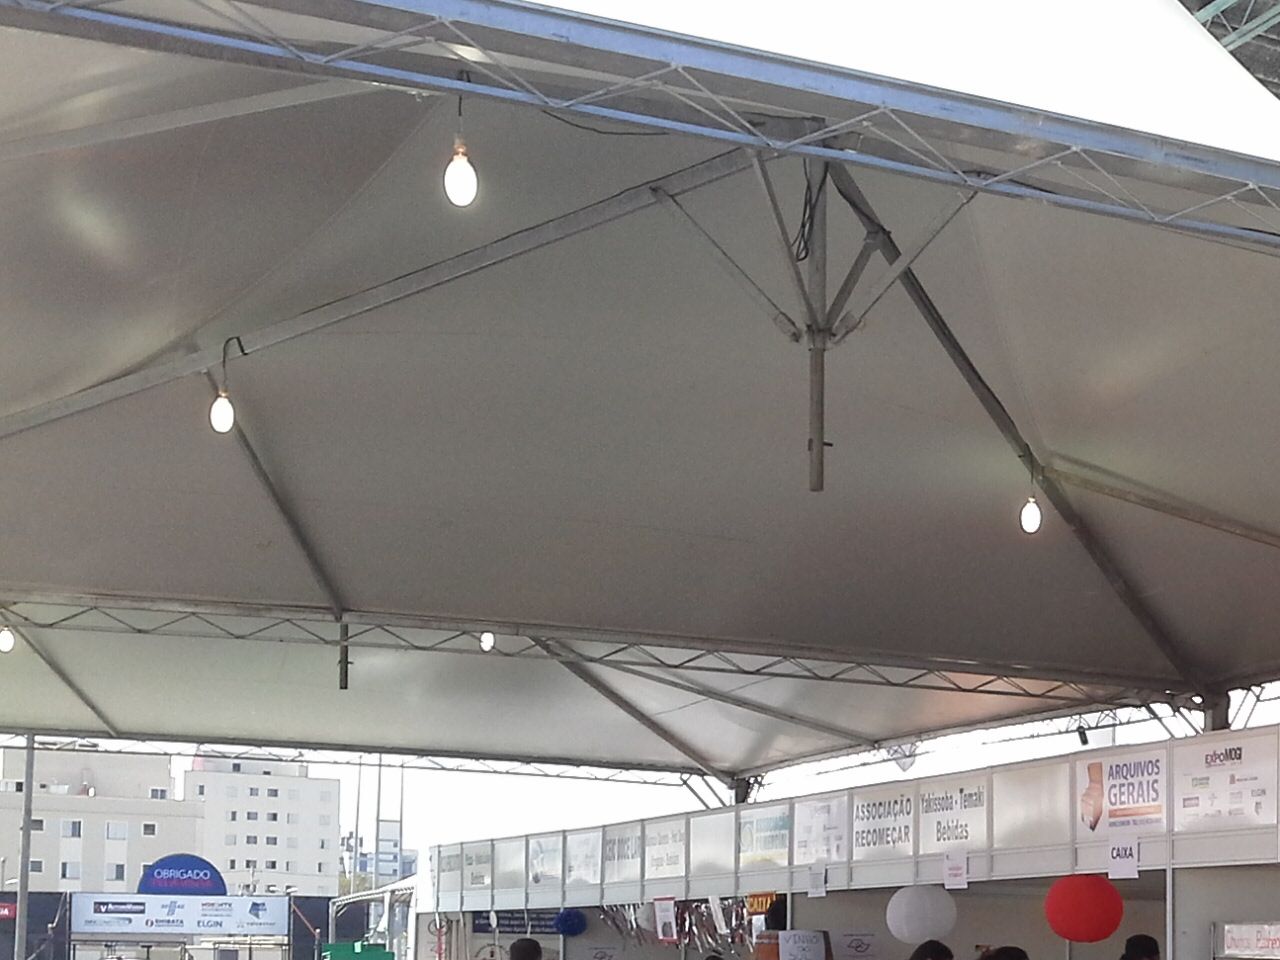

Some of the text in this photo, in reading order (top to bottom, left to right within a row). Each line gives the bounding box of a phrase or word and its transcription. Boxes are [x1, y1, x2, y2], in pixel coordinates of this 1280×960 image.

[1108, 759, 1161, 781] ARQUIVOS
[920, 790, 954, 814] Yakissoba
[959, 785, 985, 809] Temaki
[1108, 779, 1160, 806] GERAIS
[855, 794, 912, 821] ASSOCIAÇÃO
[855, 825, 910, 848] RECOMEÇAR
[936, 819, 969, 842] Bebidas
[1111, 846, 1134, 859] CAIXA
[154, 868, 210, 881] OBRIGADO
[197, 920, 223, 928] ELGIN
